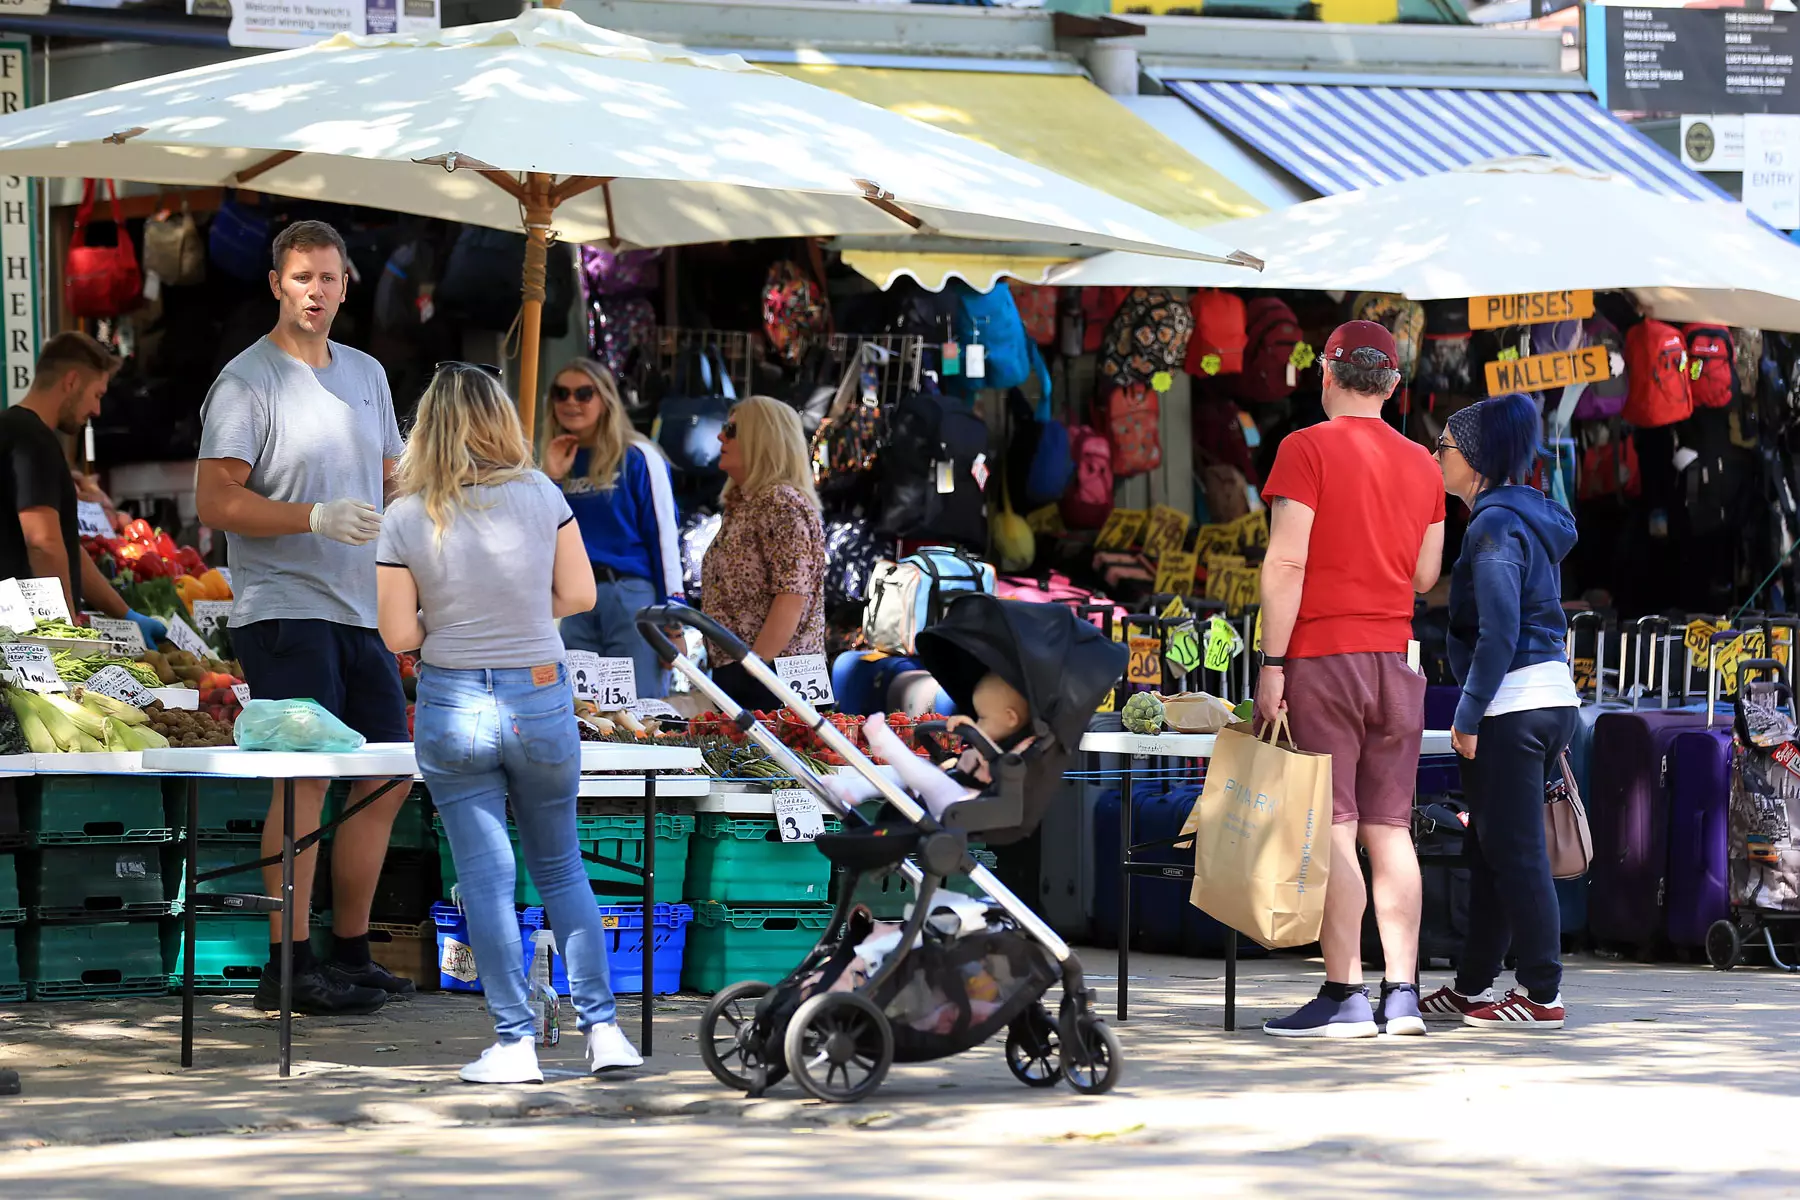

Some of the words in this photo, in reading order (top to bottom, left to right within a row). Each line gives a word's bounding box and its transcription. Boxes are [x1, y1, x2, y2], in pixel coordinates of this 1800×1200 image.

[245, 3, 291, 15] Welcome
[293, 4, 304, 15] to
[1764, 151, 1783, 165] NO
[1752, 172, 1794, 187] ENTRY
[1487, 290, 1575, 323] PURSES
[1496, 351, 1597, 392] WALLETS
[1296, 808, 1315, 895] primark.com
